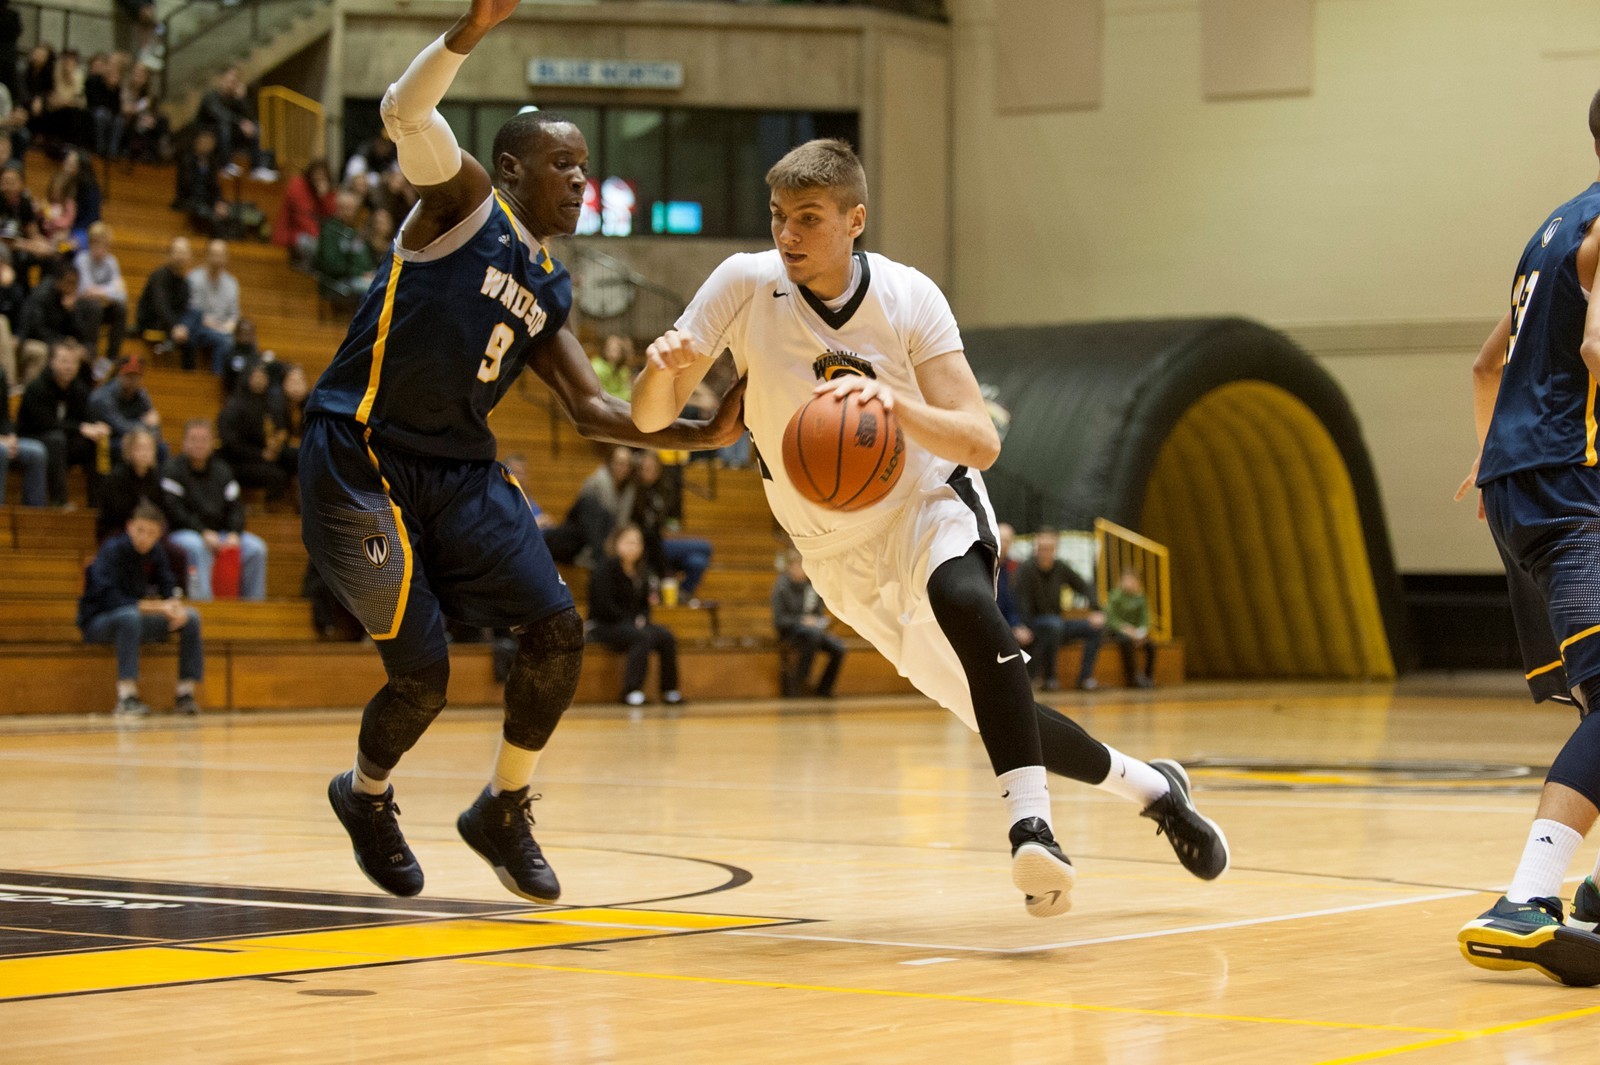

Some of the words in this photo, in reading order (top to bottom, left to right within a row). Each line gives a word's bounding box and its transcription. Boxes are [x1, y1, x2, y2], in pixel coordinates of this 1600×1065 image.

[536, 62, 590, 83] BLUE
[601, 65, 677, 86] NORTH
[476, 321, 515, 383] 9
